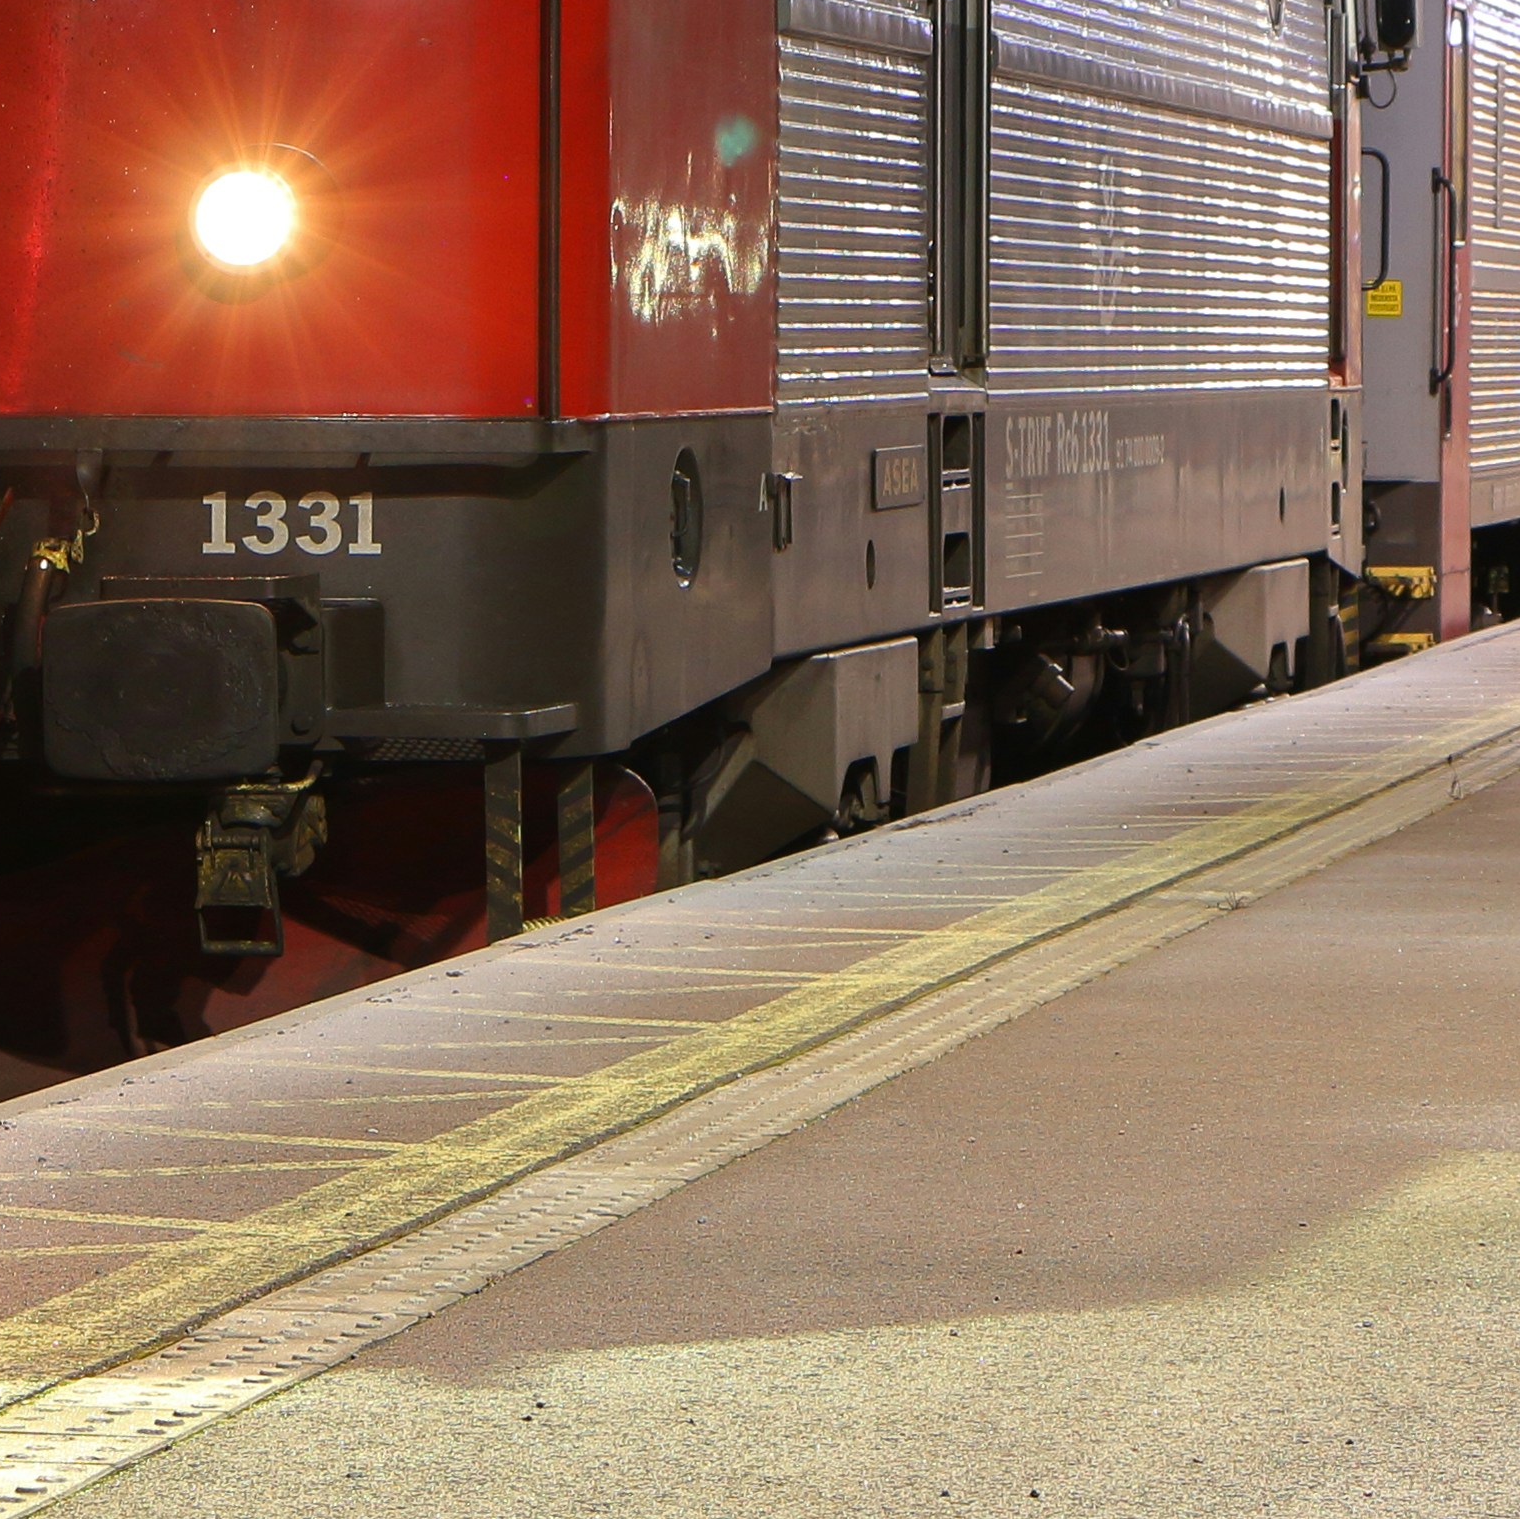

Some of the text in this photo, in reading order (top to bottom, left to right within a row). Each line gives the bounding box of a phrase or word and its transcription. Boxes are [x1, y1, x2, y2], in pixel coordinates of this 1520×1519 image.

[1005, 416, 1052, 479] S-TRVF
[1057, 410, 1080, 475] Rc6
[1081, 410, 1110, 473] 1331
[758, 472, 768, 512] A
[882, 457, 919, 497] ASEA
[200, 490, 383, 556] 1331
